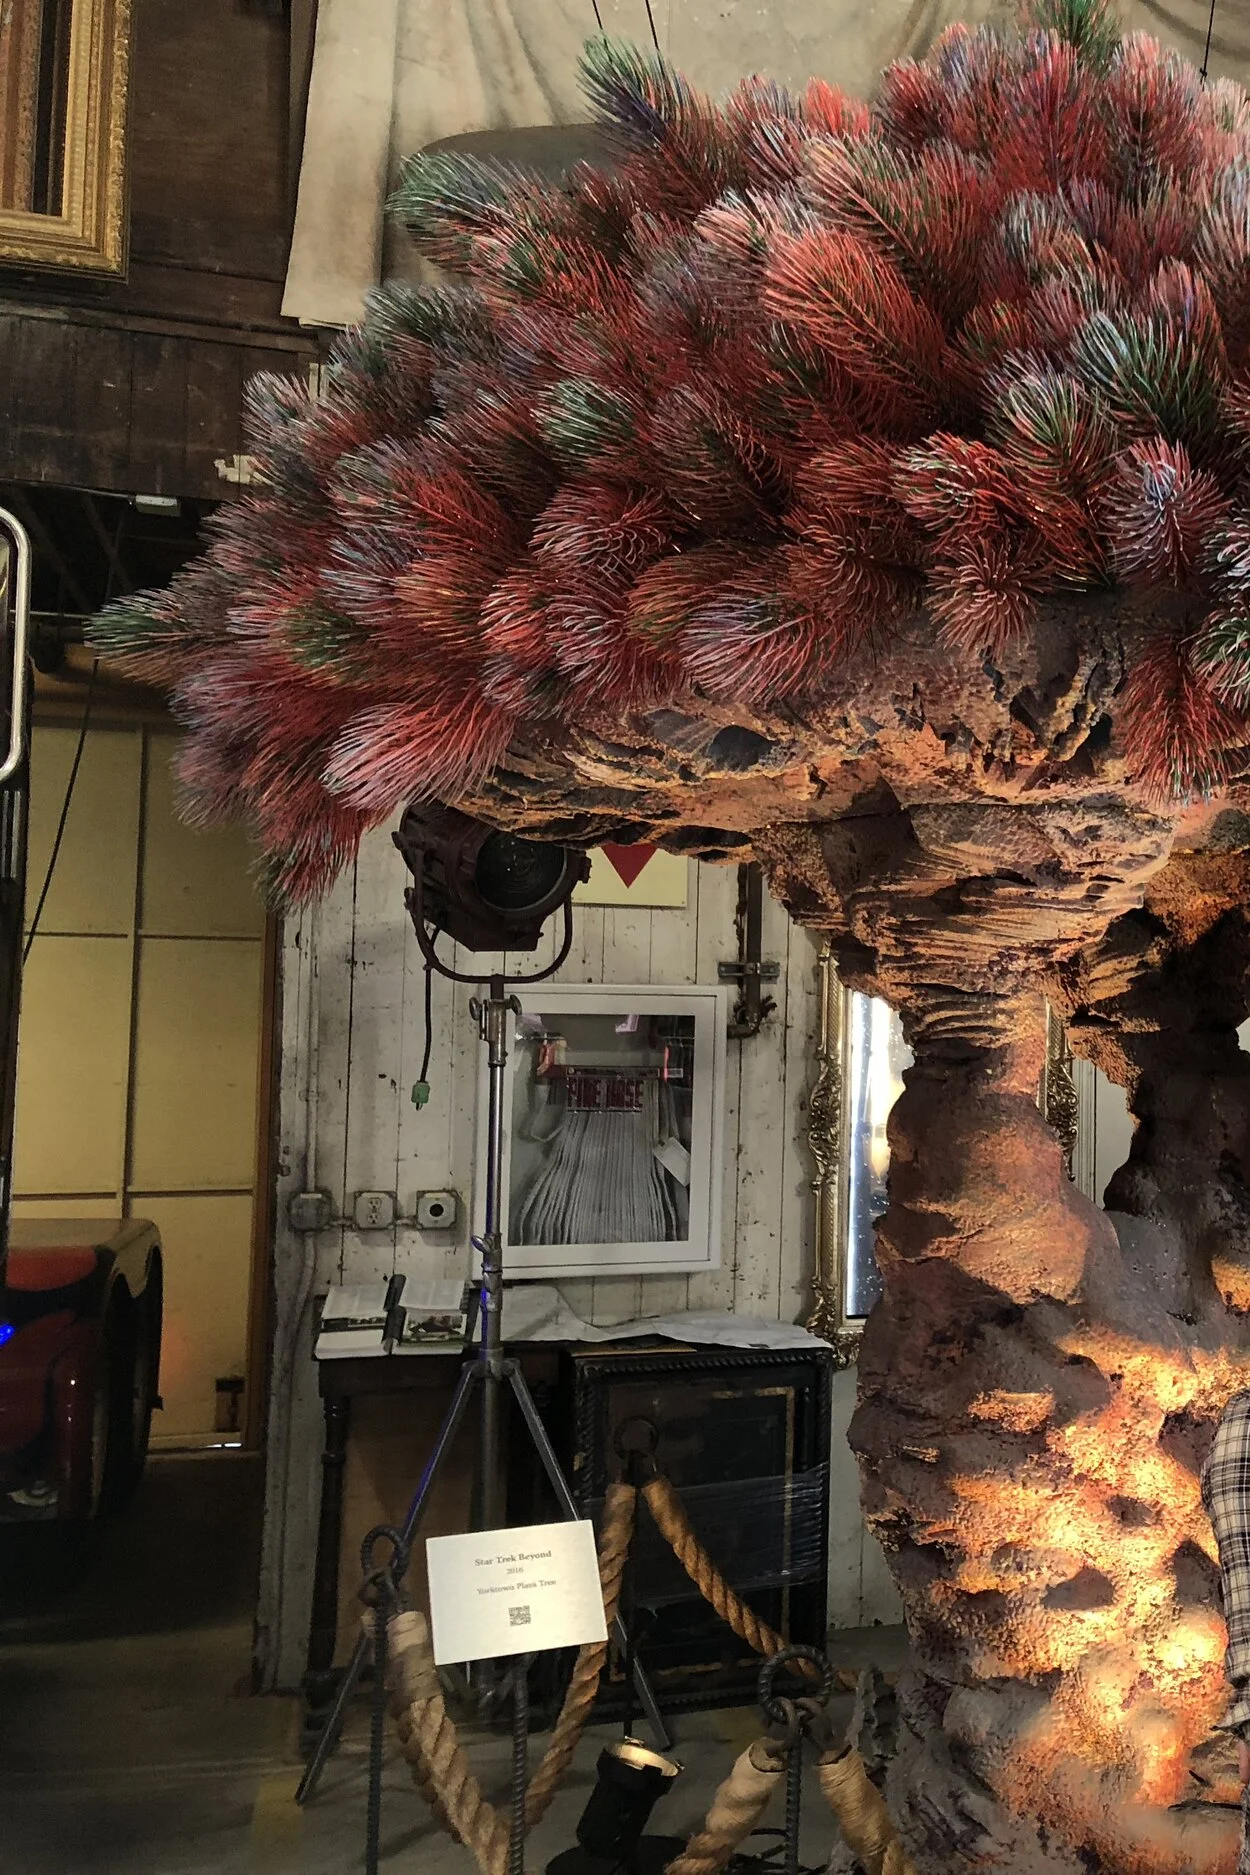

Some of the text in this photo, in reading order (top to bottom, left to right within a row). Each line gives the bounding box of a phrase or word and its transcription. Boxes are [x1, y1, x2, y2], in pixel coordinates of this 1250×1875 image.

[474, 1550, 552, 1567] Star Trek Beyond
